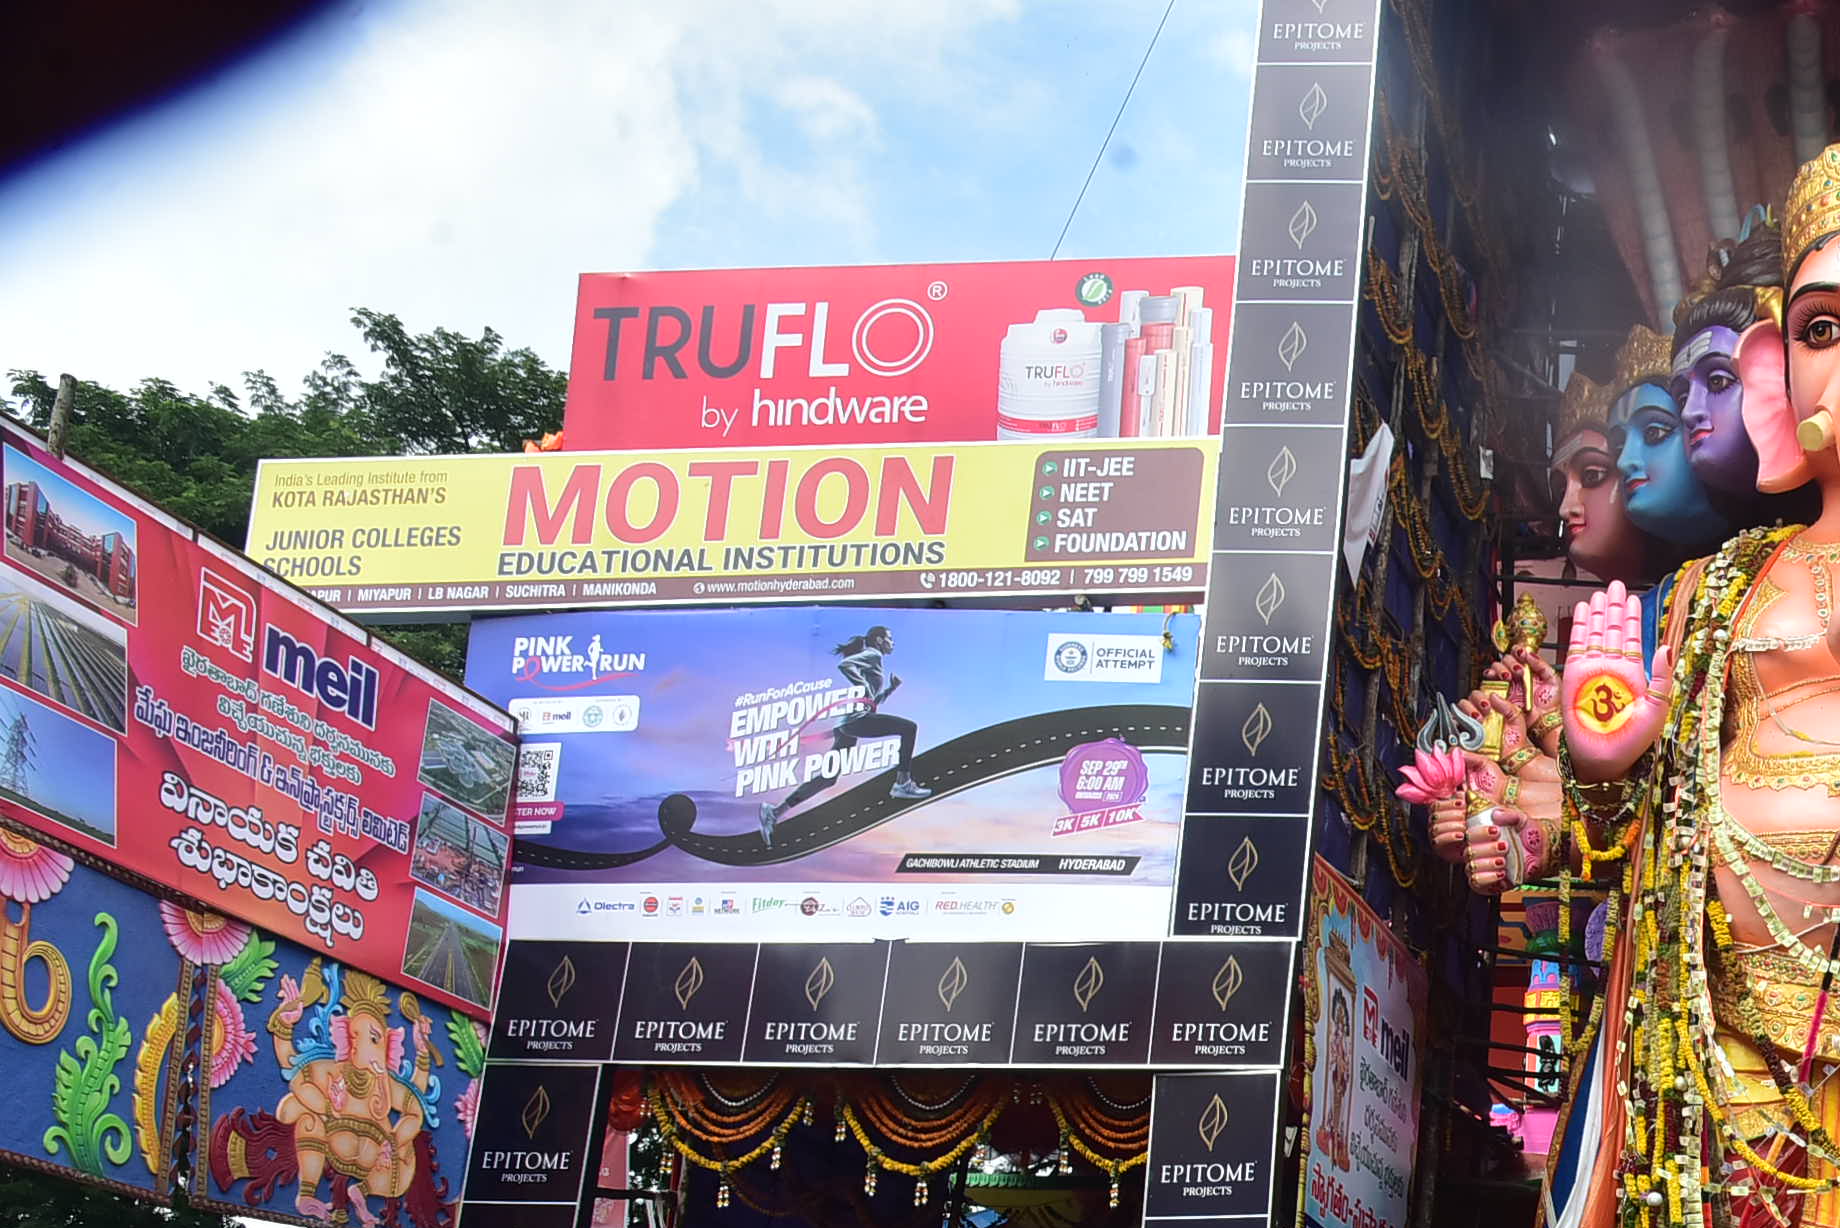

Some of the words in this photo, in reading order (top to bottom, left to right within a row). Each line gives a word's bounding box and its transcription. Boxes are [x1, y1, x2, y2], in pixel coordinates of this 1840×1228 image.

[1262, 139, 1353, 157] EPITOME
[1283, 159, 1332, 168] PROJECTS
[593, 298, 935, 381] TRUFLO
[701, 397, 738, 436] by
[751, 386, 928, 428] hindware
[1062, 457, 1135, 479] IIT-JEE
[274, 473, 313, 488] India's
[317, 472, 364, 489] Leading
[368, 471, 416, 485] Institute
[419, 470, 448, 485] from
[272, 490, 317, 508] KOTA
[323, 487, 447, 507] RAJASTHAN'S
[502, 455, 956, 546] MOTION
[1059, 482, 1114, 503] NEET
[1057, 508, 1097, 529] SAT
[1229, 507, 1324, 525] EPITOME
[266, 529, 344, 551] JUNIOR
[352, 526, 462, 548] COLLEGES
[1054, 531, 1187, 555] FOUNDATION
[1251, 528, 1302, 538] PROJECTS
[263, 555, 362, 578] SCHOOLS
[497, 550, 714, 577] EDUCATIONAL
[722, 541, 945, 571] INSTITUTIONS
[938, 569, 1060, 589] 1800-121-8092
[1084, 568, 1116, 586] 799
[1120, 567, 1155, 585] 799
[1157, 566, 1193, 583] 1549
[358, 587, 411, 602] MIYAPUR
[428, 586, 443, 600] LB
[447, 586, 489, 600] NAGAR
[505, 584, 566, 598] SUCHITRA
[582, 581, 656, 597] MANIKONDA
[708, 577, 855, 596] www.motionhyderabad.com
[513, 635, 573, 657] PINK
[1096, 647, 1156, 660] OFFICIAL
[512, 656, 584, 675] POWER
[599, 652, 646, 672] RUN
[1095, 658, 1156, 671] ATTEMPT
[264, 623, 380, 731] meil
[730, 684, 867, 739] EMPOWER
[733, 729, 801, 767] WITH
[735, 760, 800, 798] PINK
[803, 738, 901, 784] POWER
[1079, 760, 1101, 776] SEP
[1201, 767, 1299, 787] EPITOME
[1075, 776, 1102, 791] 6:00
[1103, 776, 1125, 791] AM
[1223, 789, 1276, 800] PROJECTS
[1053, 818, 1075, 833] 3K
[1081, 813, 1101, 828] 5K
[1108, 808, 1135, 824] 10K
[160, 771, 301, 863] వినాయక
[305, 839, 379, 901] చవితి
[1000, 858, 1040, 870] STADIUM
[1058, 858, 1126, 872] HYDERABAD
[897, 1023, 992, 1042] EPITOME
[918, 1045, 969, 1056] PROJECTS
[1380, 1015, 1410, 1082] meil
[481, 1151, 571, 1170] EPITOME
[500, 1173, 548, 1184] PROJECTS
